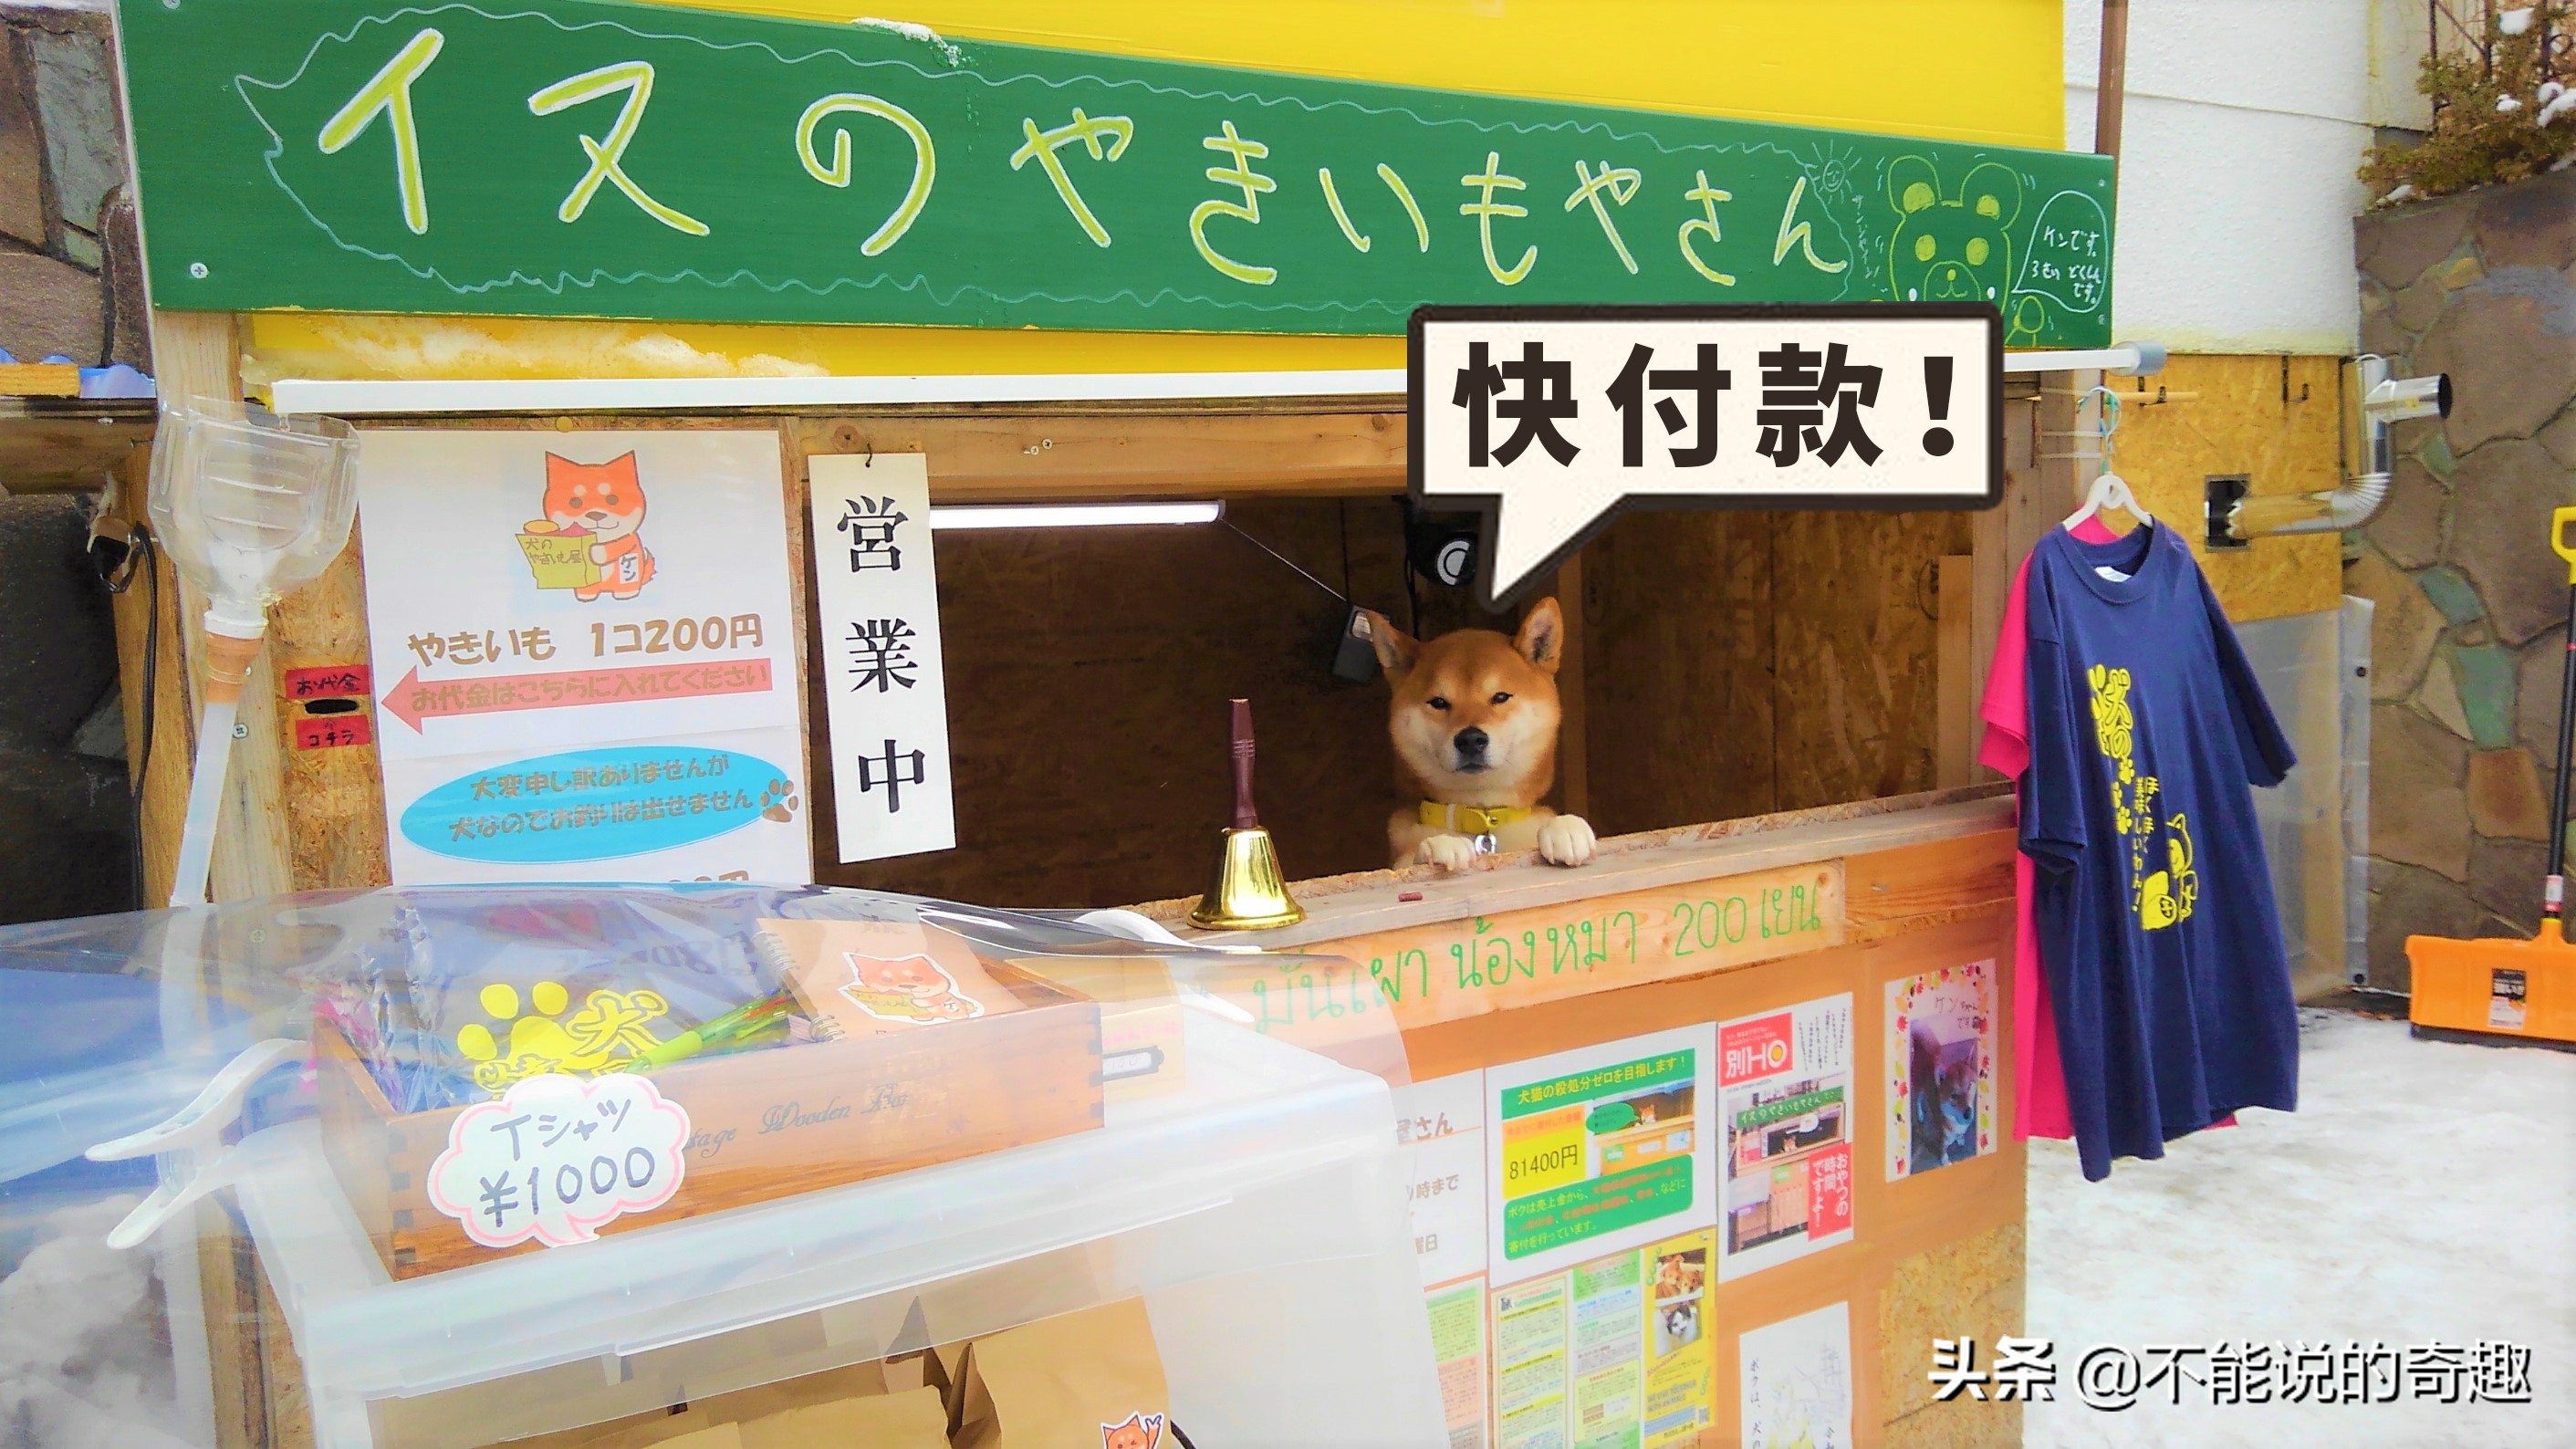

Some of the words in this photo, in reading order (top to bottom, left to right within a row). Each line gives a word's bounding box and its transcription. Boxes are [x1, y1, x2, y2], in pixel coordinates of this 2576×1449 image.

[317, 27, 1850, 287] イヌのやきいもやさん
[525, 537, 553, 551] 犬の
[621, 555, 638, 581] ケン
[407, 625, 558, 669] やきいも
[590, 612, 764, 657] 1コ200円
[837, 495, 926, 814] 営業中
[297, 672, 361, 695] お代金
[411, 662, 769, 714] お代金はこちらに入れてください
[308, 730, 355, 747] コチラ
[469, 754, 732, 802] 大変申し訳ありませんが
[449, 789, 755, 843] 犬なのでお釣りは出せません
[490, 1098, 633, 1162] Tシャツ
[758, 1096, 851, 1134] Wooden
[1508, 1143, 1579, 1181] 81400円
[479, 1146, 657, 1229] ¥1000
